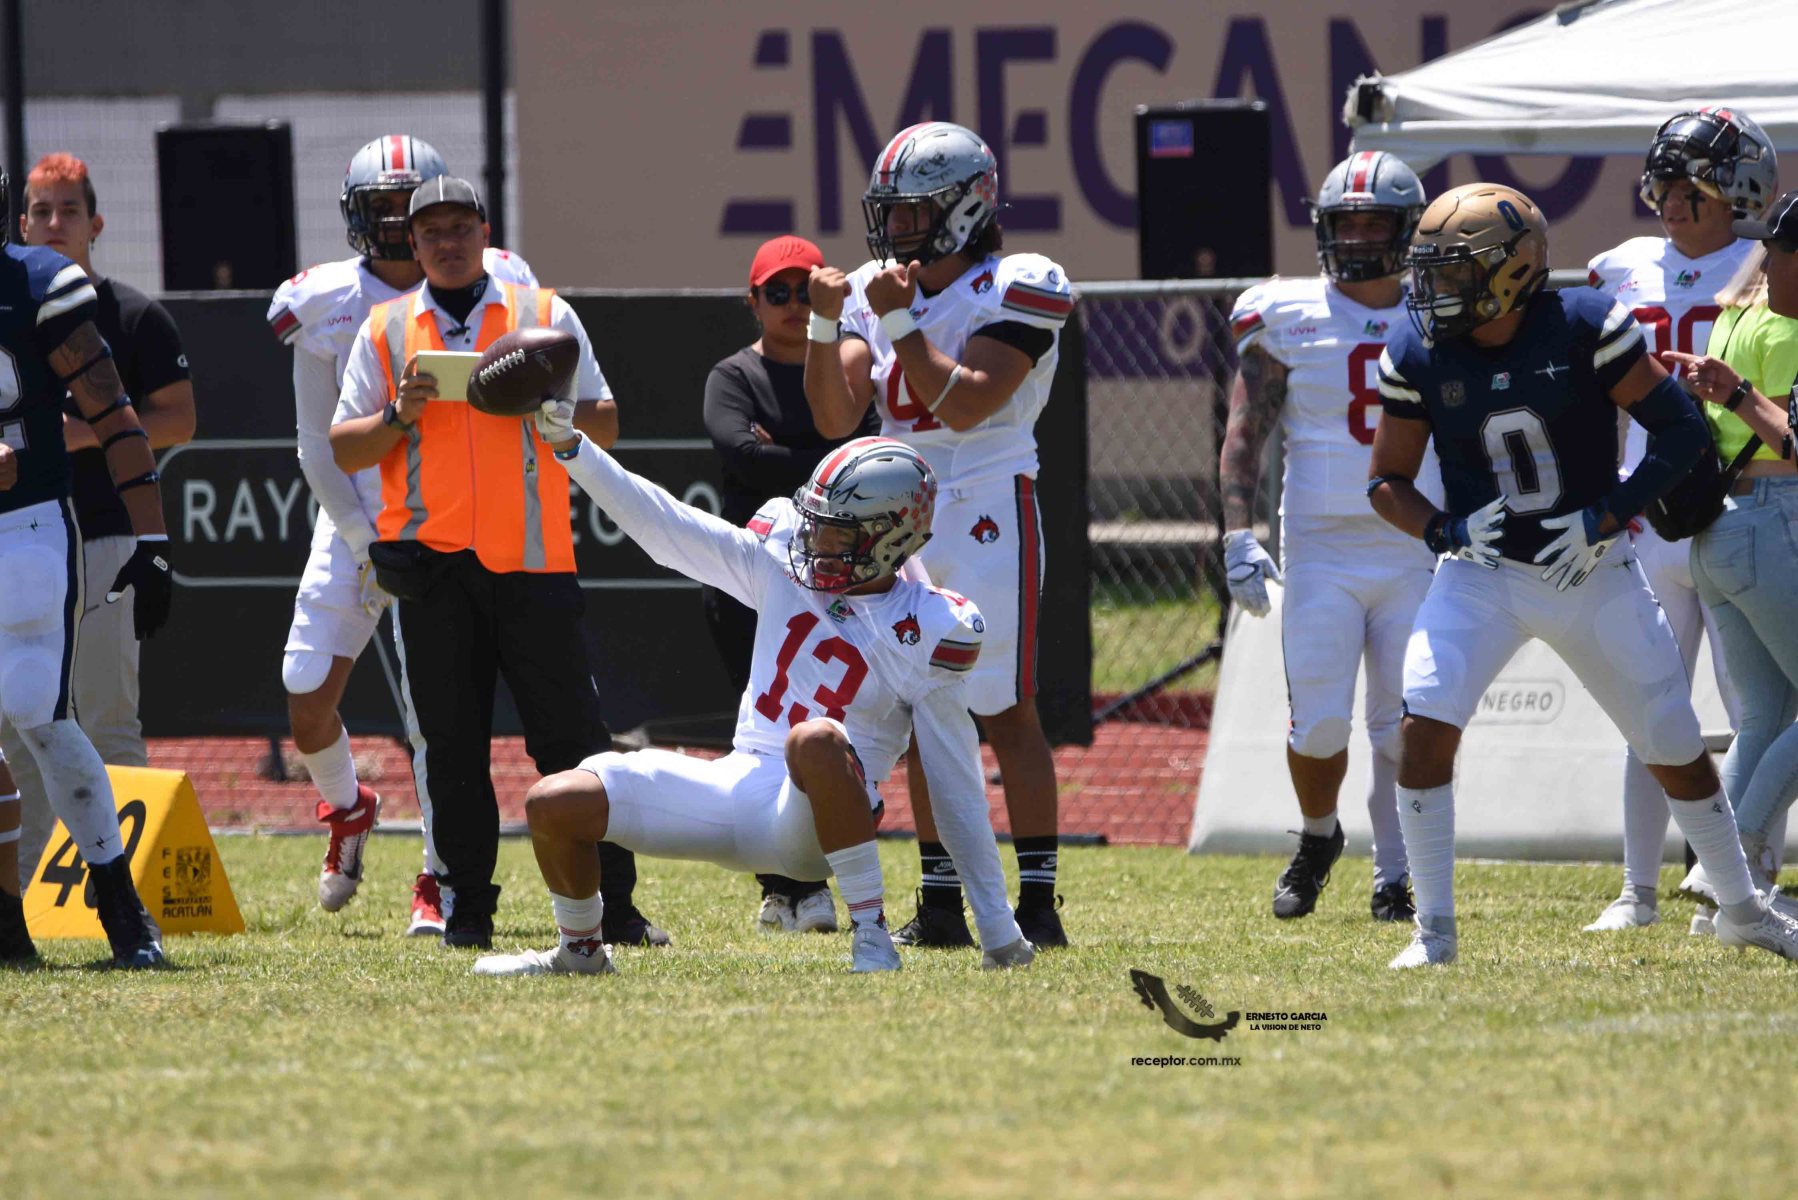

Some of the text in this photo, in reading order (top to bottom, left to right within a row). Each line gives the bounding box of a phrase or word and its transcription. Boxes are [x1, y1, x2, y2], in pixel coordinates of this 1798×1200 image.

[327, 315, 352, 327] UVM
[1288, 325, 1318, 337] UVM
[887, 357, 942, 432] 4
[1479, 405, 1564, 516] 0
[182, 478, 316, 543] RAY
[755, 611, 869, 729] 13
[1482, 690, 1554, 713] NEGRO
